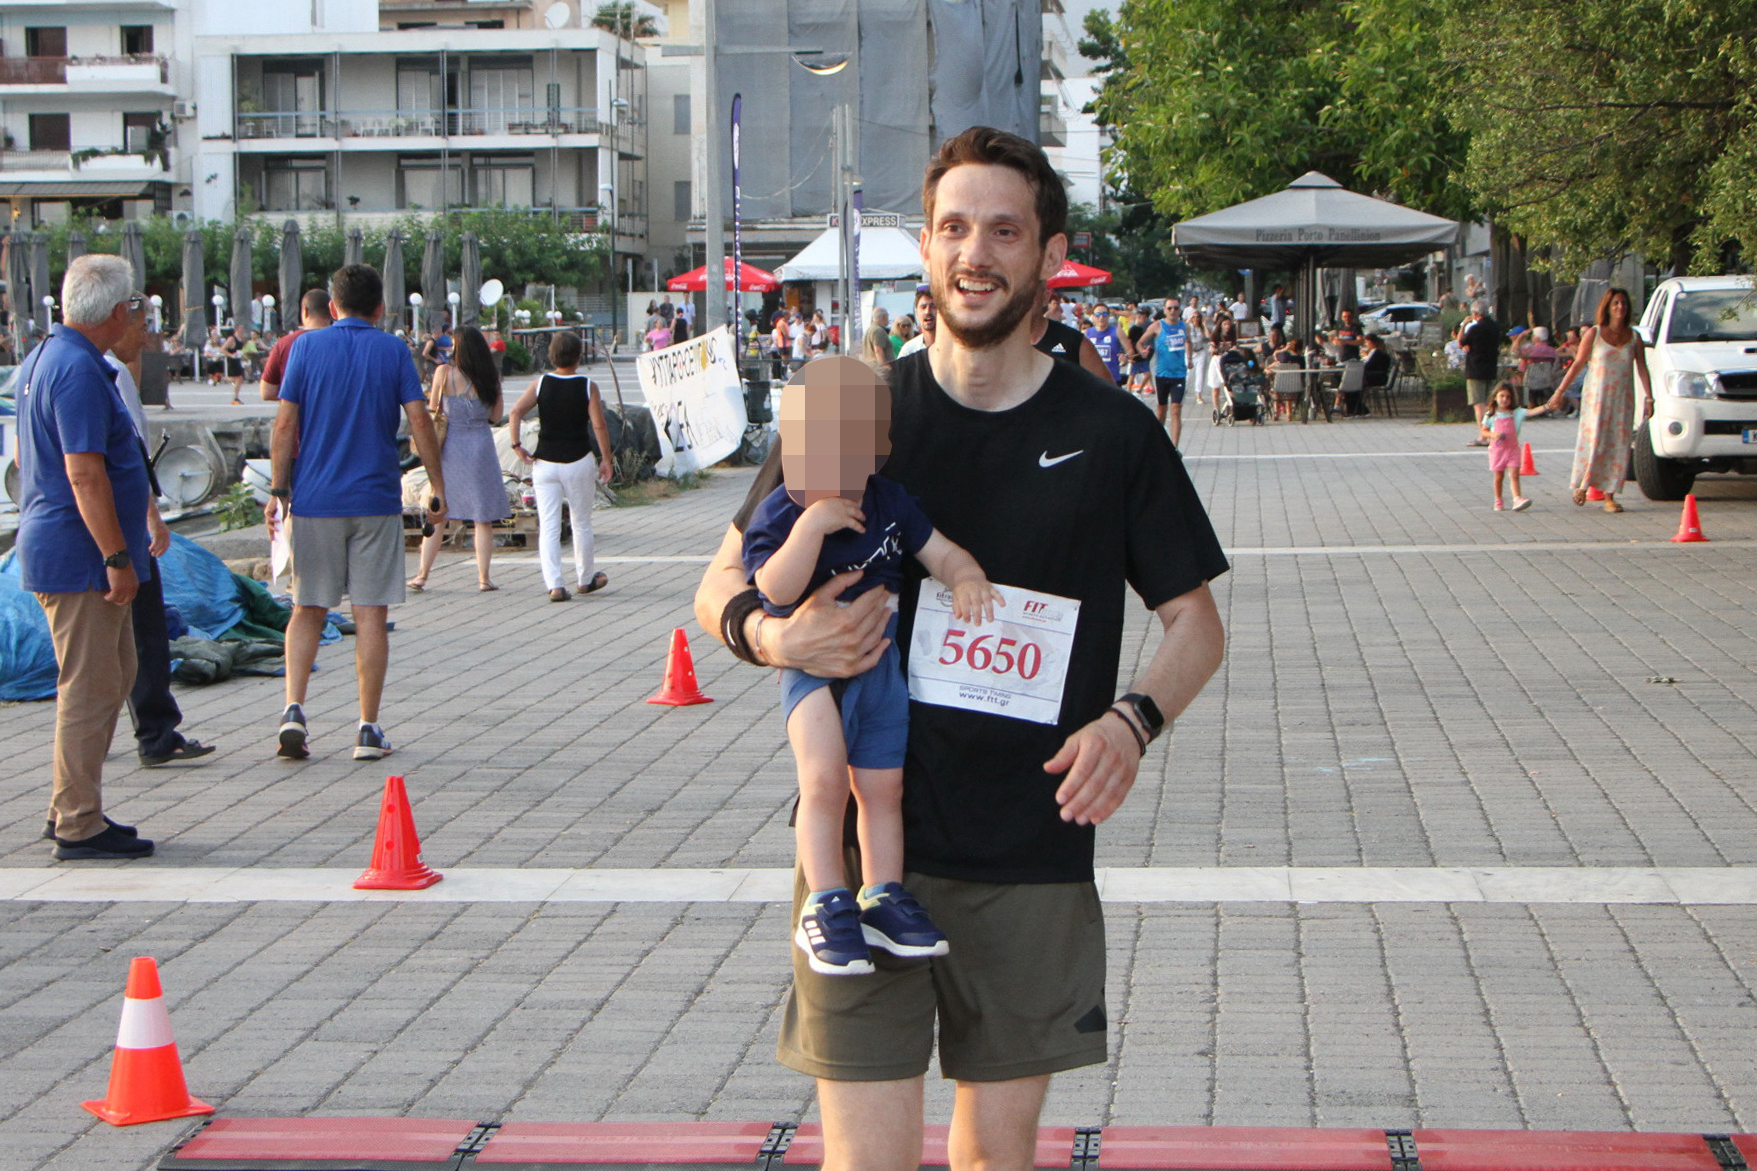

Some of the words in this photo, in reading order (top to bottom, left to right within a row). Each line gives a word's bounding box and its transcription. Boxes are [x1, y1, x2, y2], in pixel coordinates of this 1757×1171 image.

[861, 215, 897, 226] XPRESS
[1256, 228, 1292, 241] Pizzeria
[1298, 228, 1324, 241] Porto
[1024, 600, 1048, 614] FIT
[938, 629, 1041, 680] 5650
